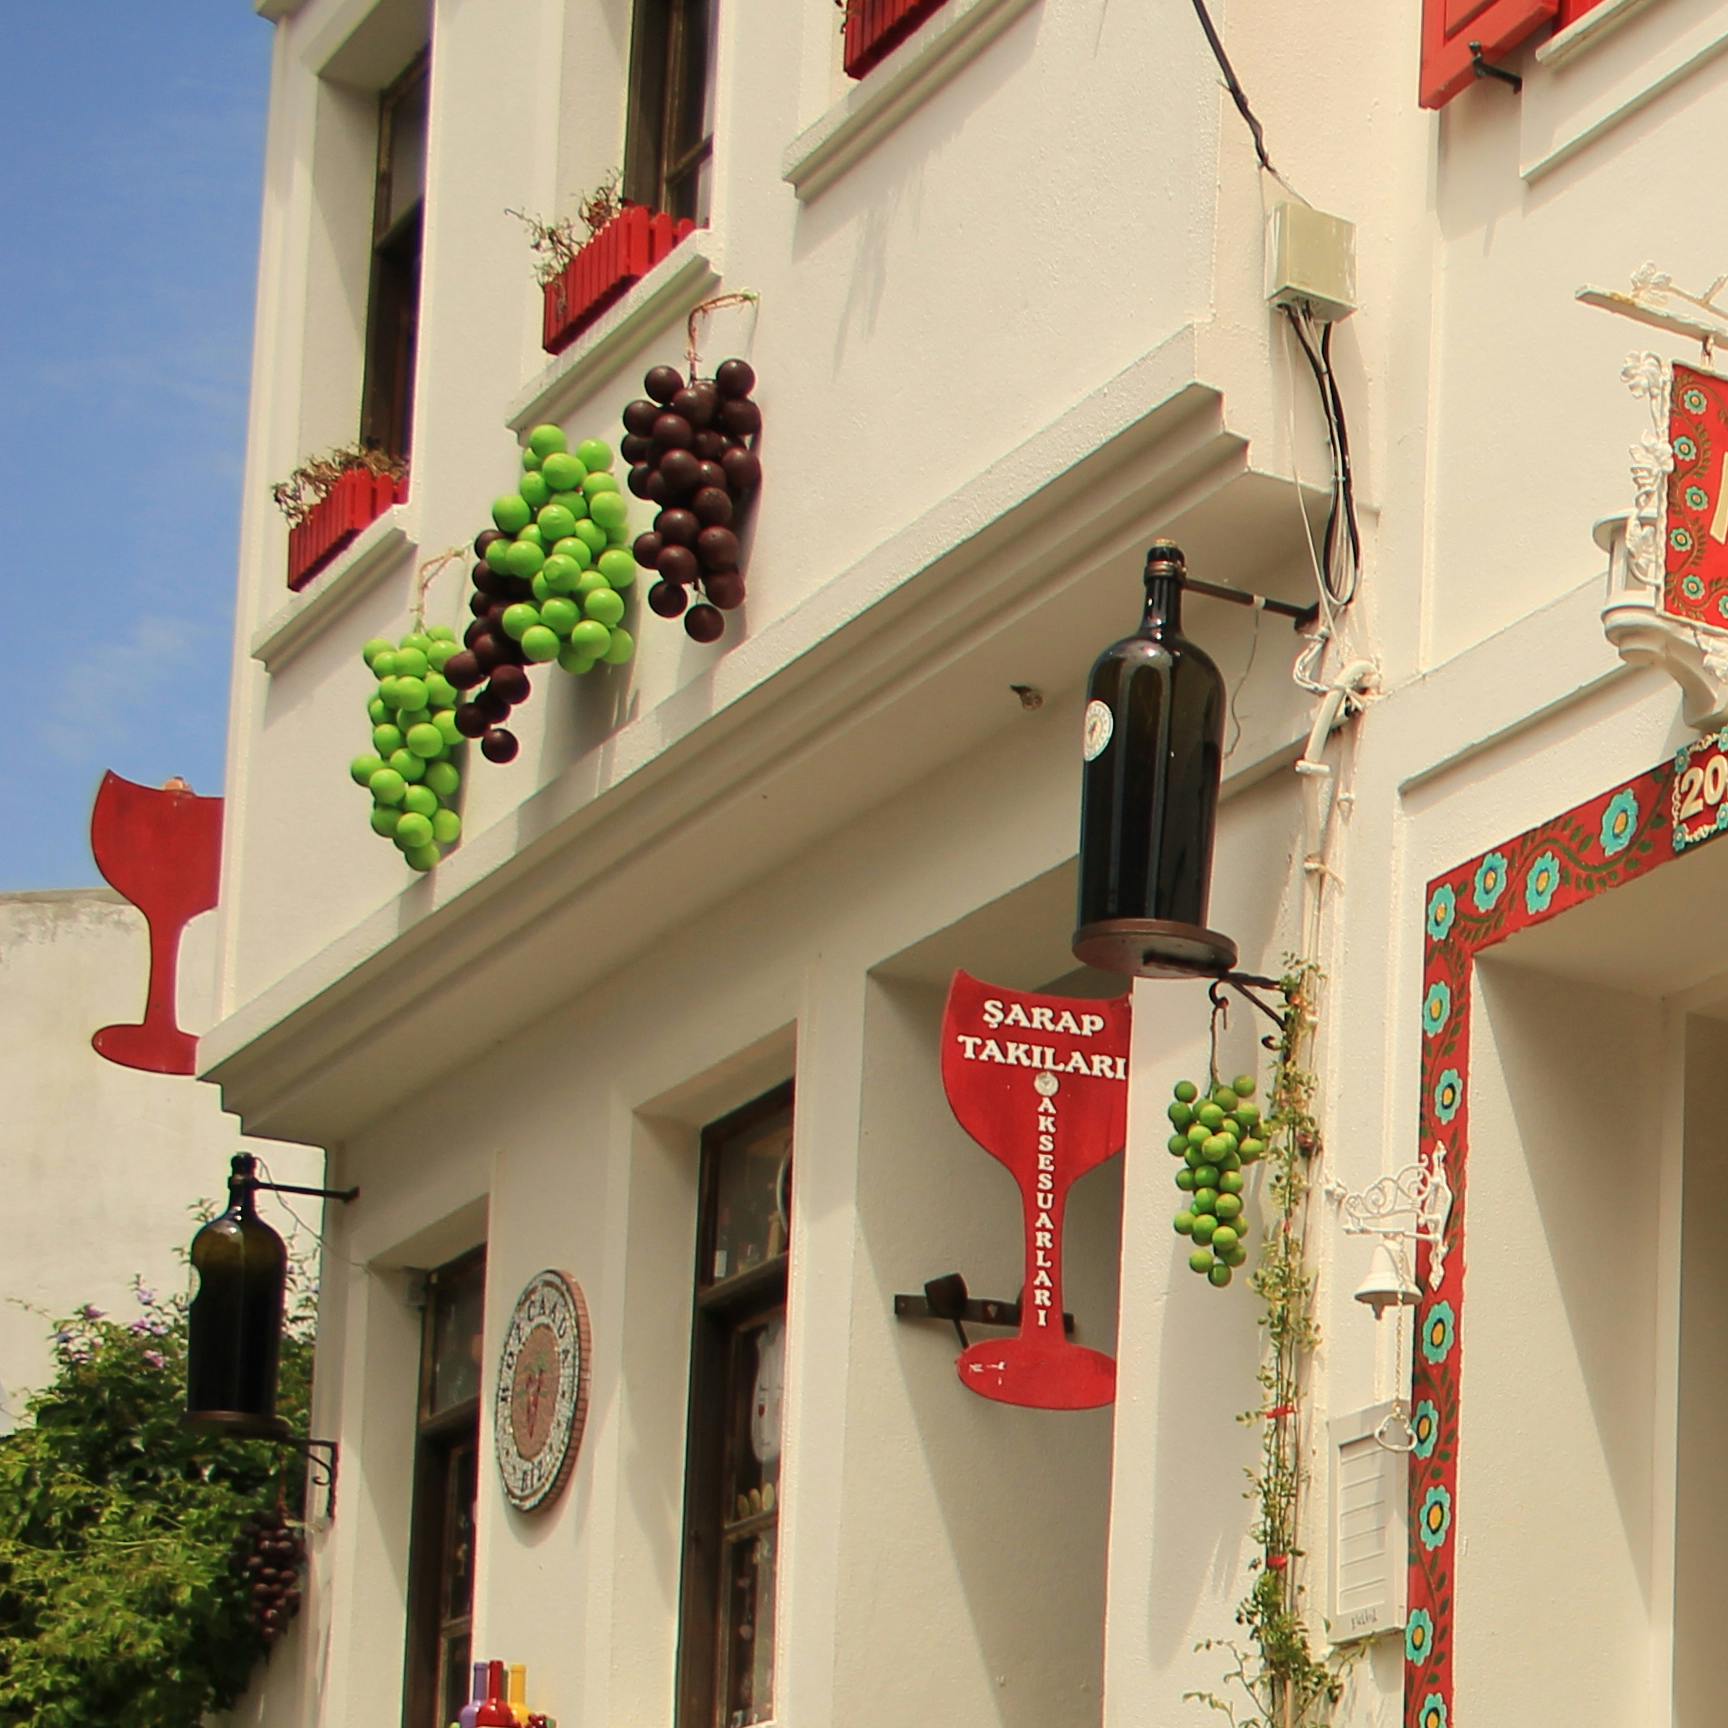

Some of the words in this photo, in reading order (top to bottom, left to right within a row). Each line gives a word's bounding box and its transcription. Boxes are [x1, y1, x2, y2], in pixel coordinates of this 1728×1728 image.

[1680, 754, 1728, 820] 20
[982, 999, 1105, 1038] ŞARAP
[956, 1034, 1127, 1081] TAKILARI
[1033, 1096, 1057, 1327] AKSESUARLARI
